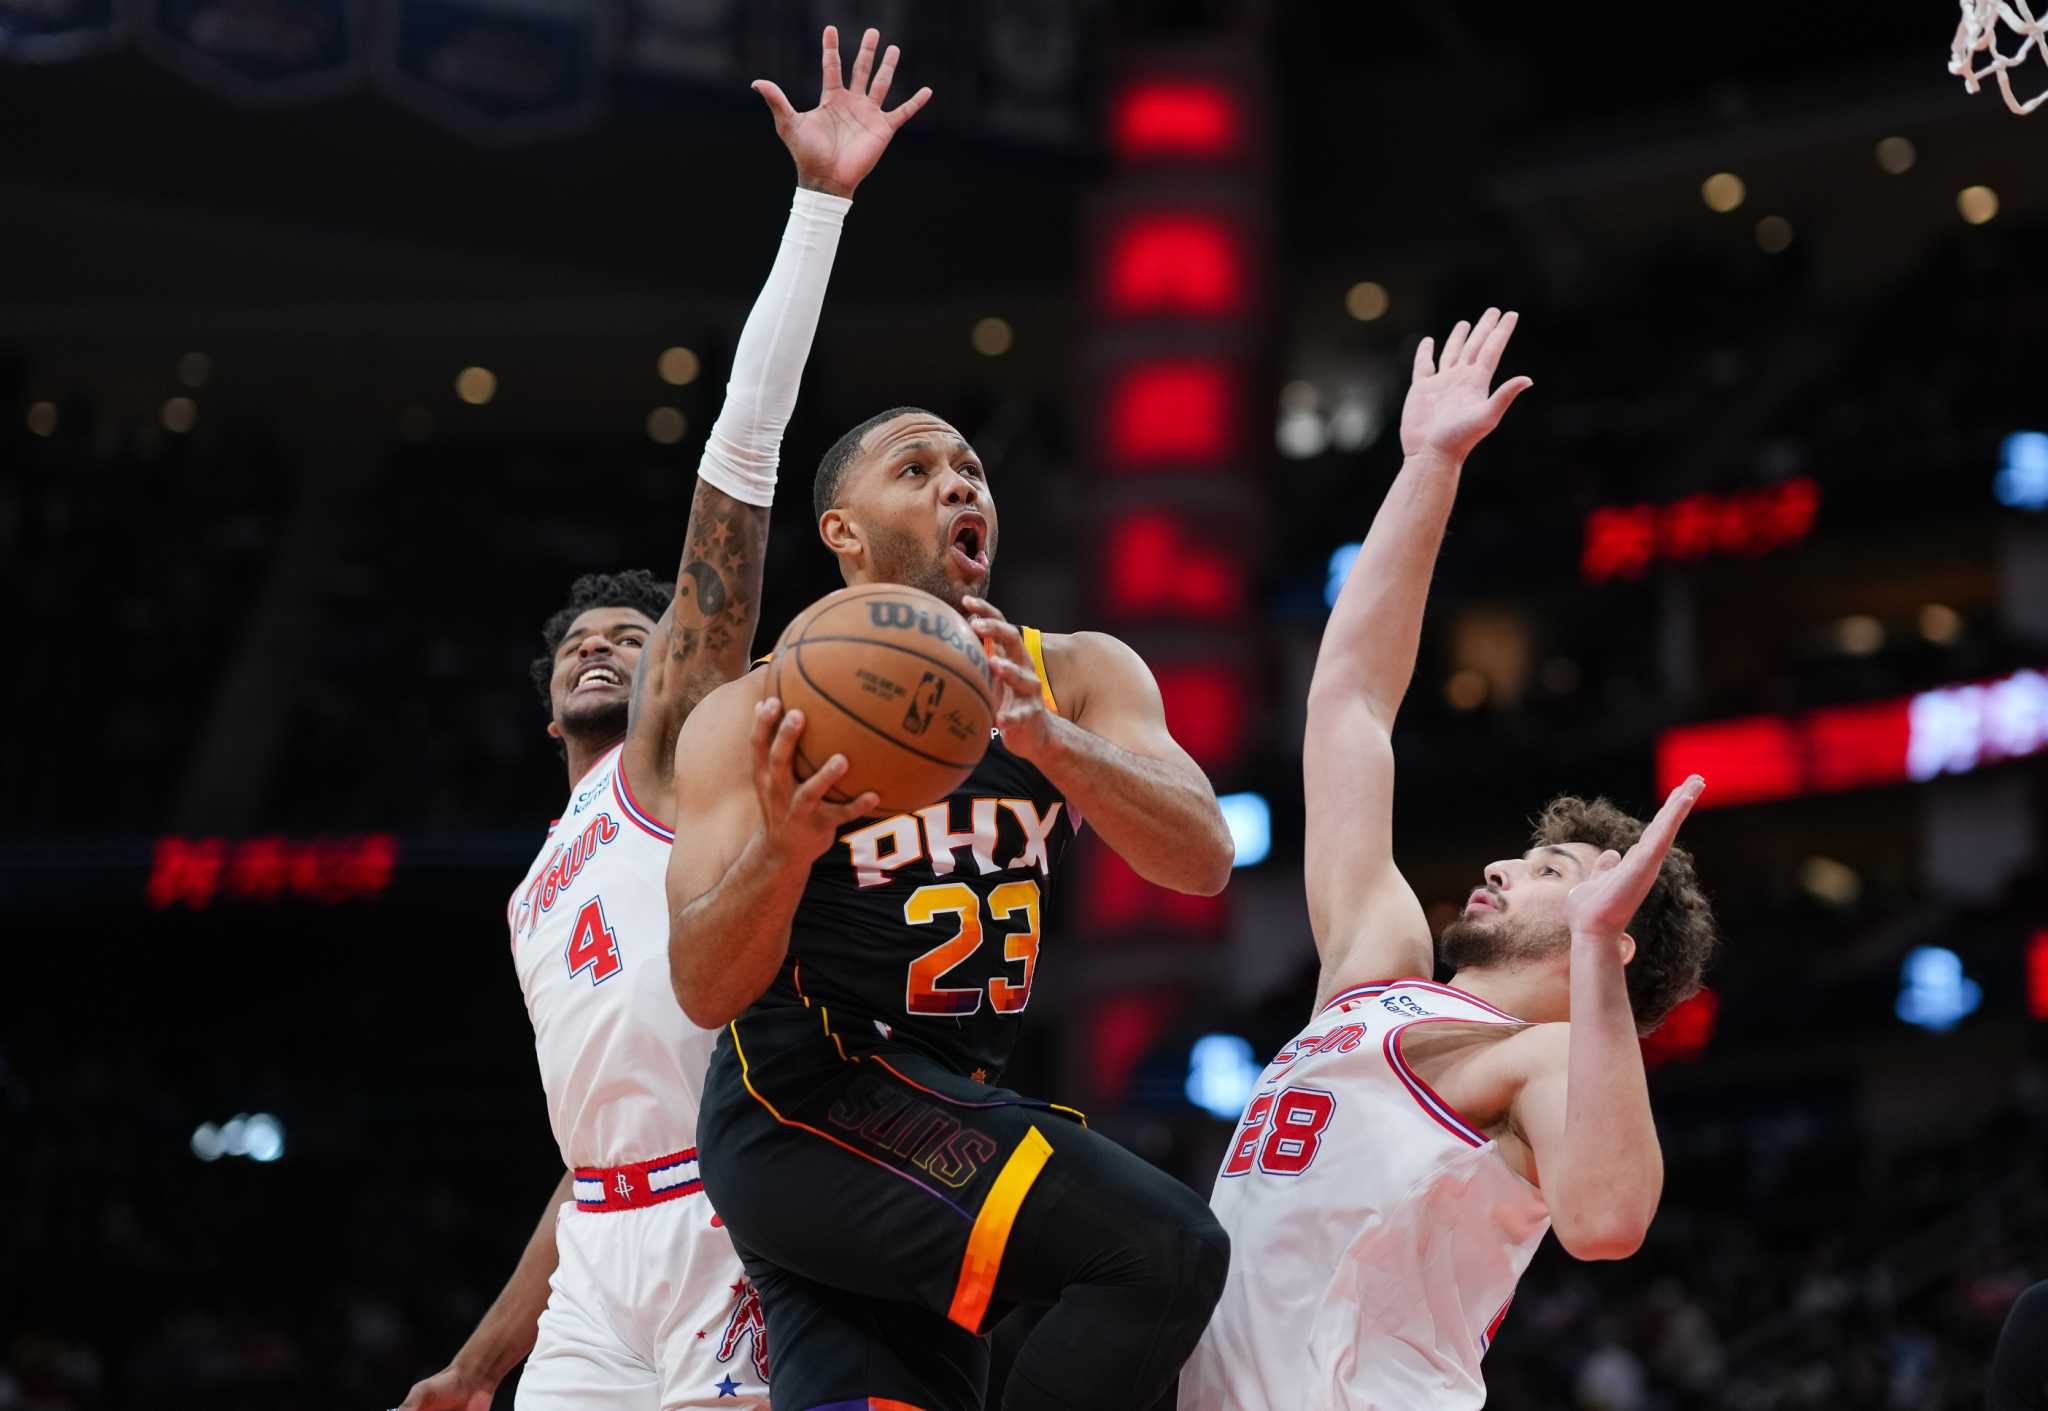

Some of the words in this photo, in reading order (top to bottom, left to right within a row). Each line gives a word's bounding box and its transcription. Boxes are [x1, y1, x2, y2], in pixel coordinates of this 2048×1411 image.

[865, 601, 993, 689] Wilson
[839, 797, 1065, 888] PHX
[564, 894, 623, 987] 4
[903, 880, 1041, 1017] 23
[1220, 1086, 1337, 1178] 28
